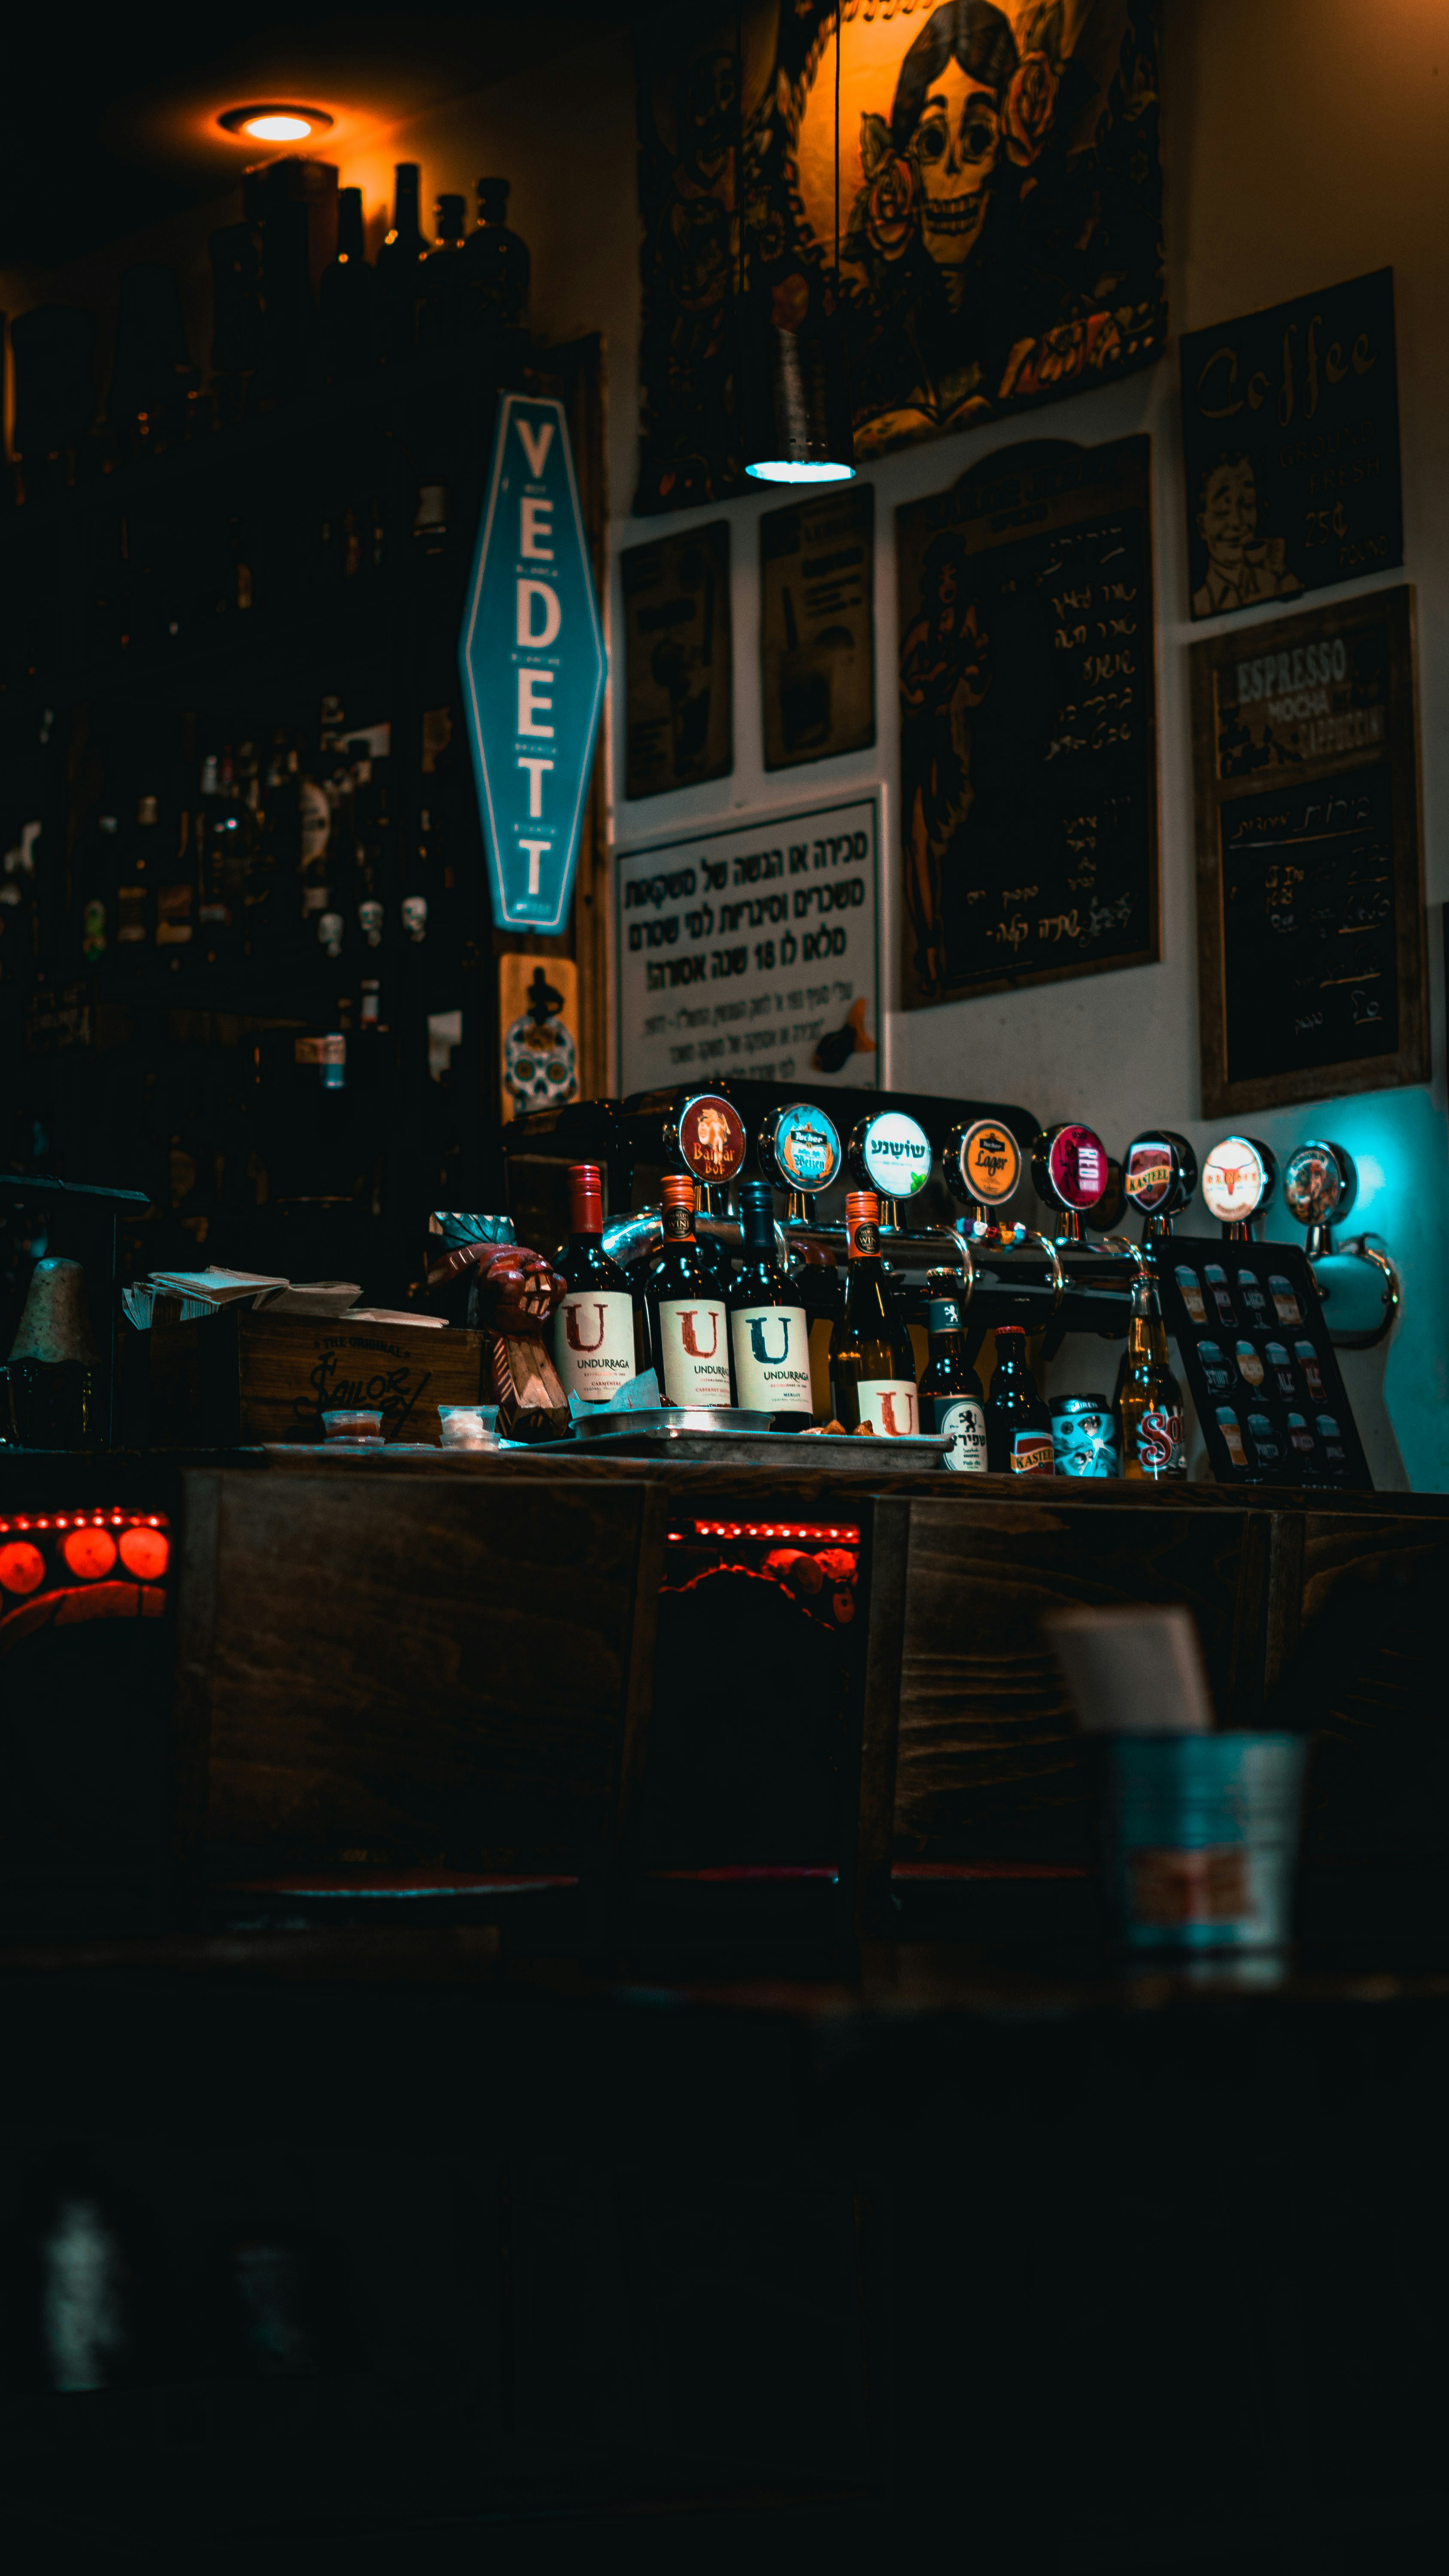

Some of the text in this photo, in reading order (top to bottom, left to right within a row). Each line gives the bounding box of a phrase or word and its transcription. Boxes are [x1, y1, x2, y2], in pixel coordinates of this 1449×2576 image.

[1196, 314, 1378, 428] Coffee
[1279, 420, 1374, 469] GROUND
[1309, 454, 1381, 495] FRESH
[924, 479, 1021, 532] SAILOR
[1304, 501, 1349, 549] 25¢
[1339, 535, 1388, 568] POUND
[513, 419, 562, 895] VEDETT
[1237, 638, 1346, 704] ESPRESSO
[1268, 689, 1330, 723] MOCHA
[734, 850, 783, 885] הגשה
[790, 844, 808, 872] או
[814, 832, 868, 868] מכירה
[702, 859, 727, 892] של
[795, 878, 864, 917] משכרים
[685, 902, 714, 938] למי
[755, 941, 775, 968] 18
[781, 930, 795, 965] לו
[803, 923, 845, 960] מלאו
[712, 946, 747, 978] שנה
[796, 1133, 823, 1143] Tucher
[975, 1150, 1008, 1176] Lager
[1130, 1169, 1168, 1191] KASTEEL
[562, 1303, 608, 1352] U
[675, 1310, 719, 1359] U
[746, 1317, 791, 1364] U
[323, 1338, 401, 1358] THE ORIGINAL
[577, 1359, 629, 1371] UNDURRAGA
[764, 1371, 808, 1382] UNDURRAGA
[876, 1391, 913, 1436] U
